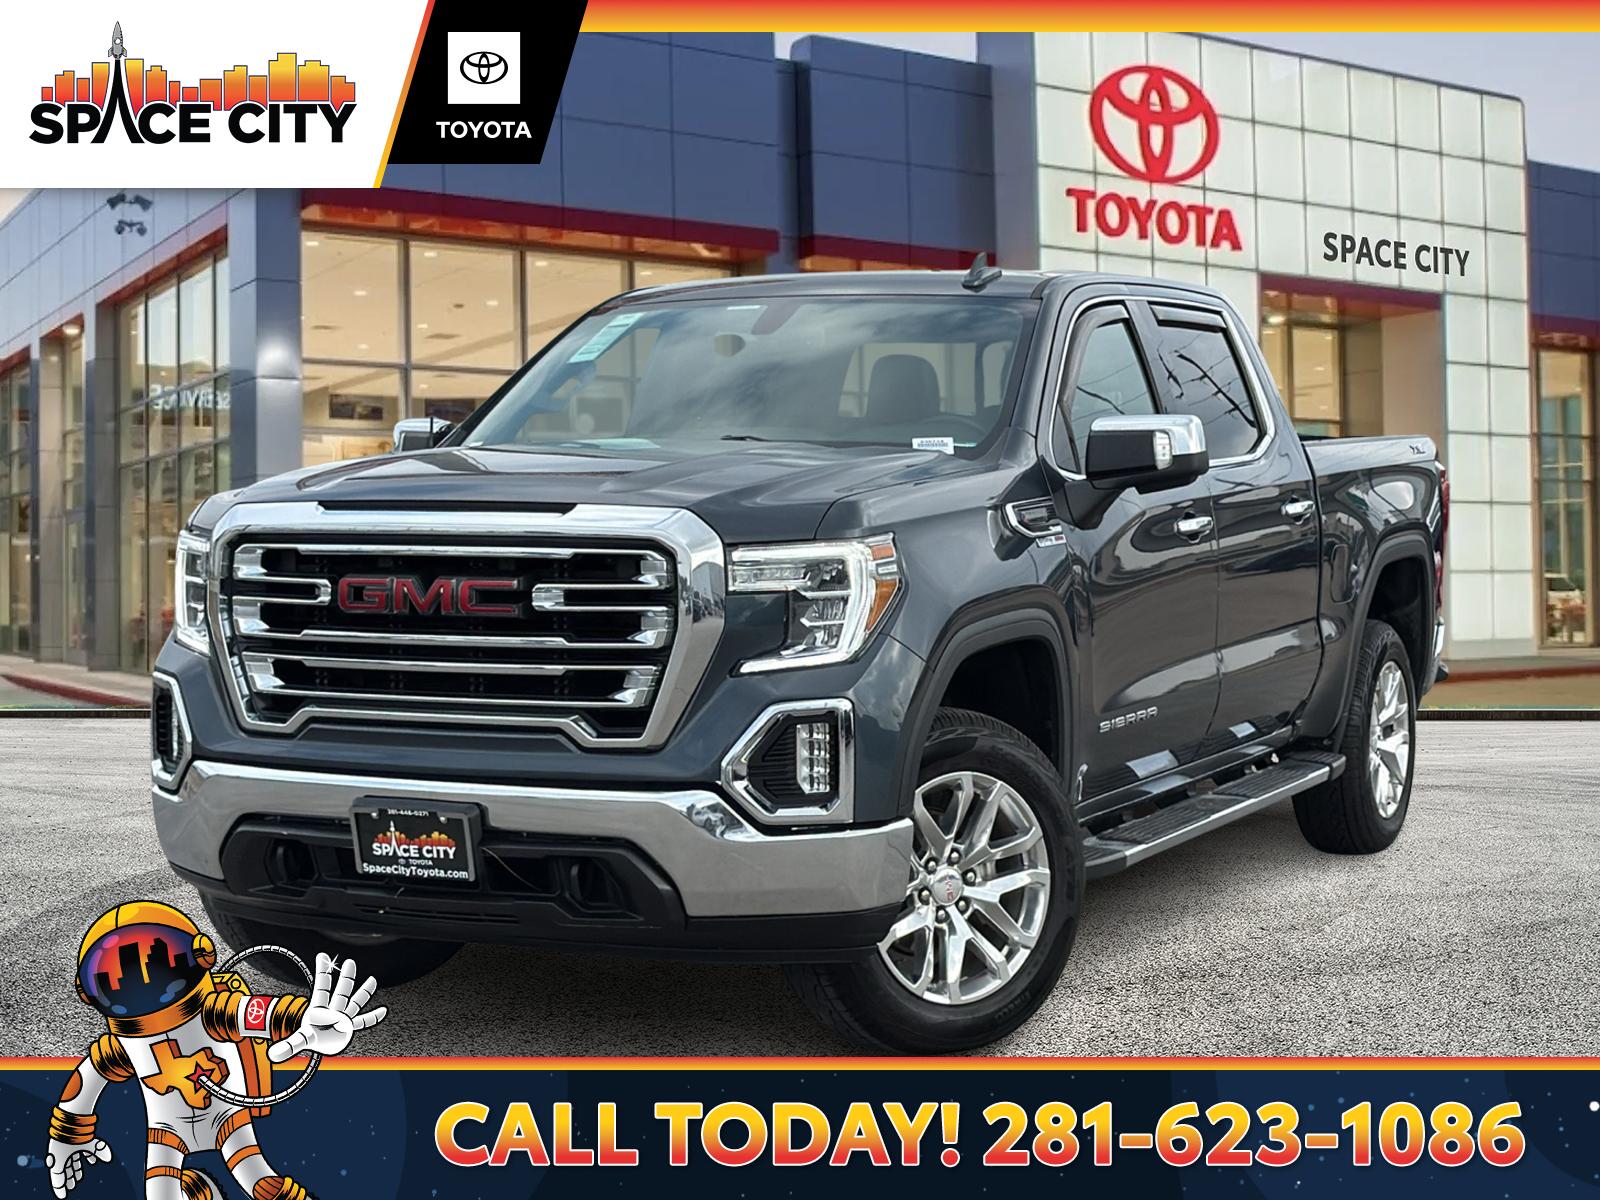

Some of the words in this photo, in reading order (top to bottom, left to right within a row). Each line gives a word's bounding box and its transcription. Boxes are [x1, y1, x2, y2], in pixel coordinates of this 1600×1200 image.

[1066, 187, 1243, 251] TOYOTA
[1323, 231, 1407, 270] SPACE
[1414, 244, 1470, 277] CITY
[337, 573, 525, 618] GMC
[1098, 706, 1159, 733] SIERRA
[372, 842, 419, 857] SPACE
[422, 845, 456, 859] CITY
[362, 862, 468, 878] SpaceCityToyota.com
